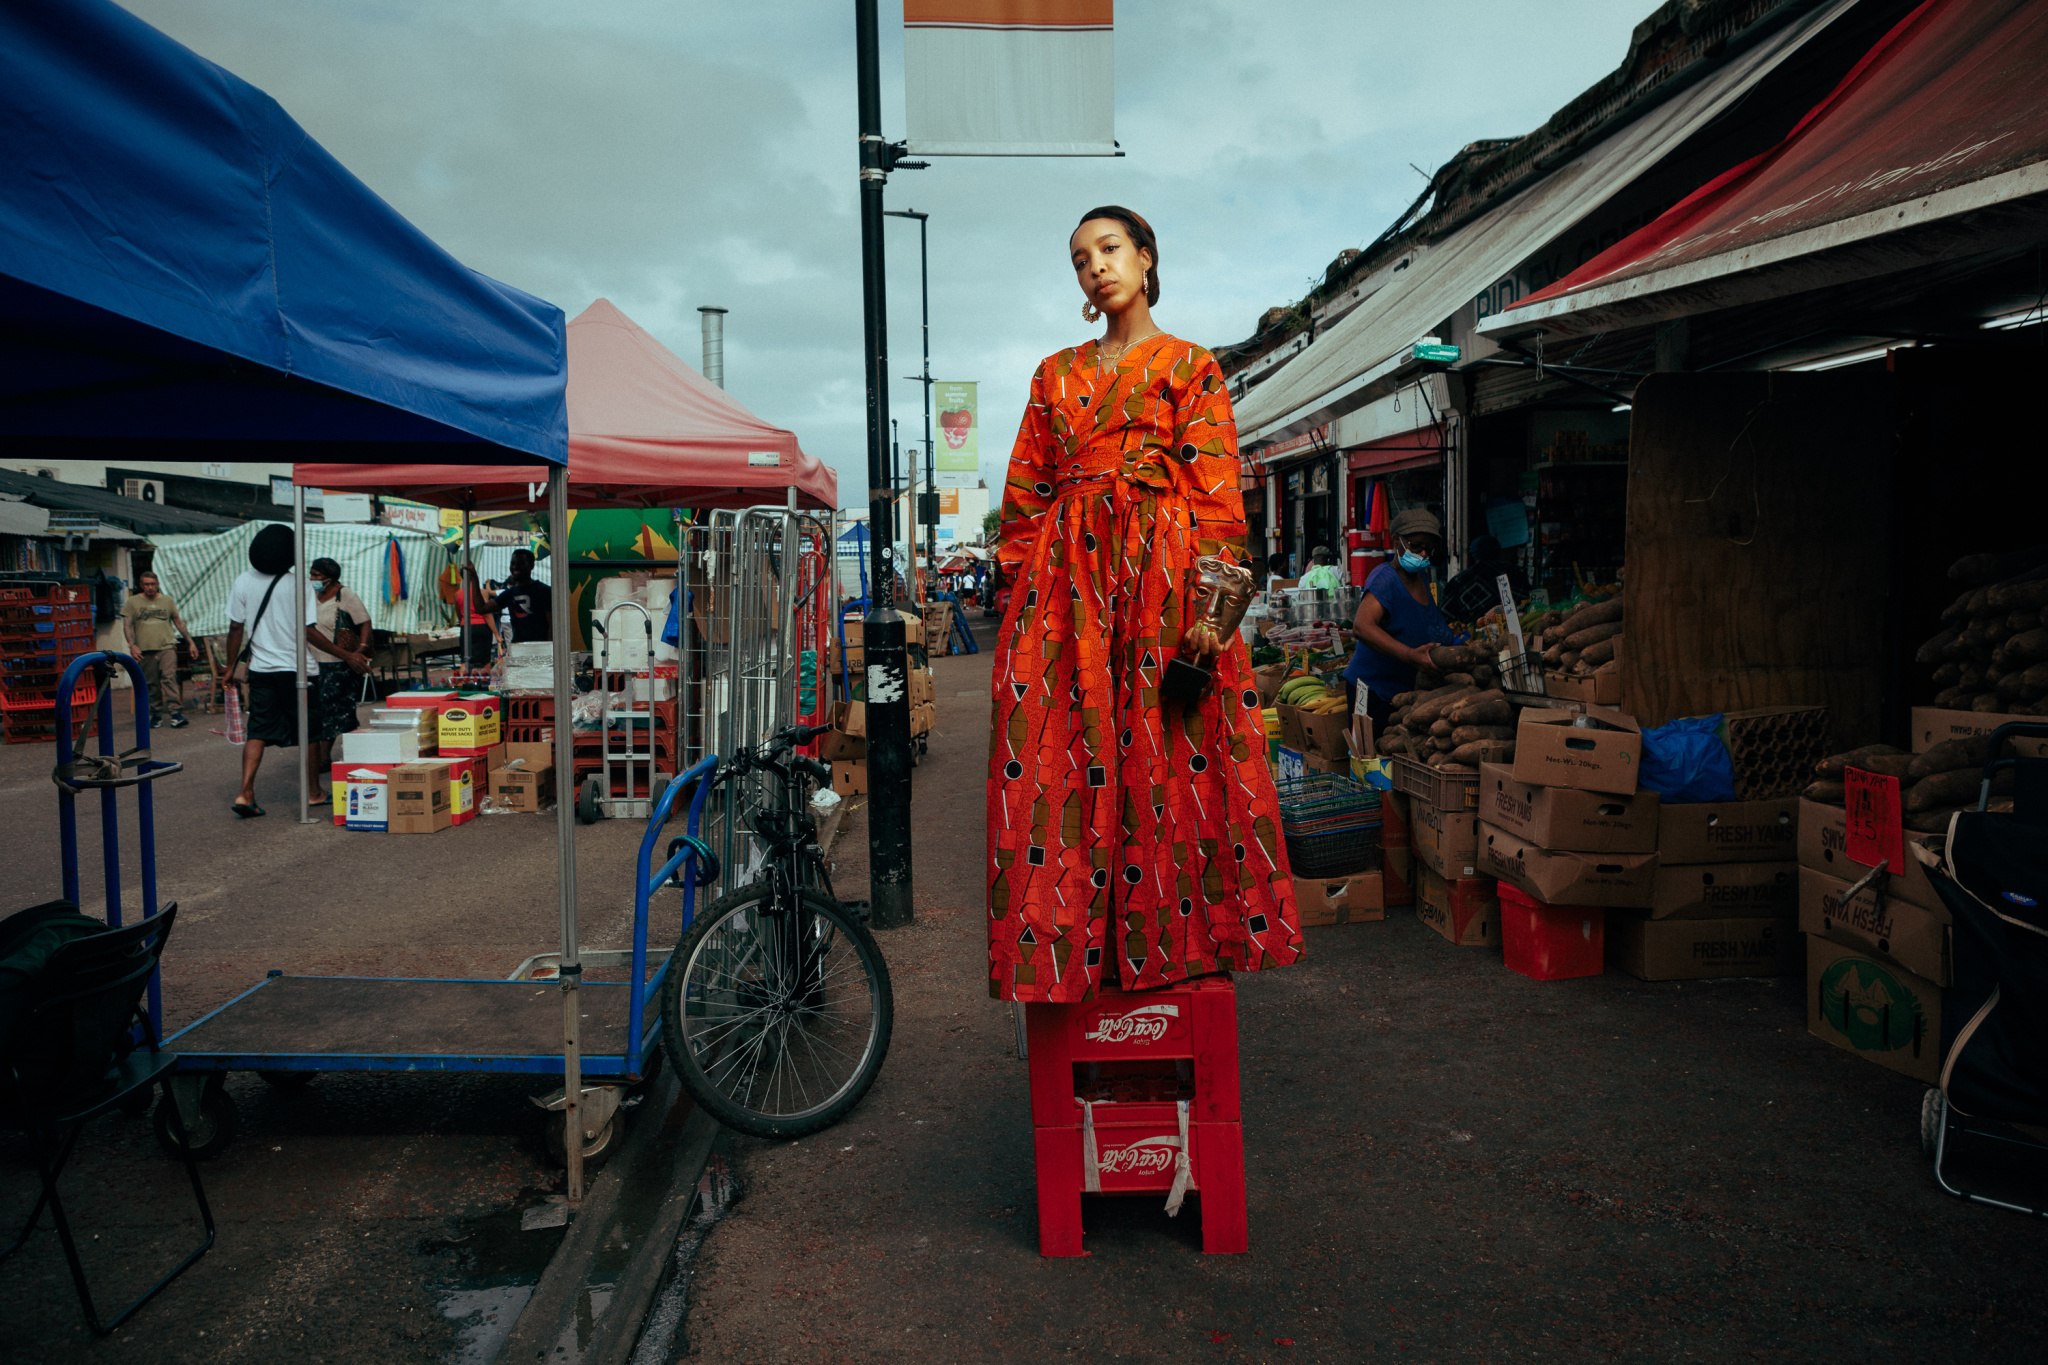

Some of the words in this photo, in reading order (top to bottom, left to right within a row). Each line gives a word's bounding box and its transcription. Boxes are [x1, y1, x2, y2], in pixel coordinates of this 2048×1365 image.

[1950, 725, 1972, 735] GHANA
[1578, 760, 1602, 770] 20kgs.
[1495, 791, 1517, 816] FRESH
[1515, 801, 1532, 823] YAMS
[1707, 826, 1752, 843] FRESH
[1756, 825, 1793, 843] YAMS
[1488, 846, 1507, 869] FRESH
[1505, 856, 1526, 879] YAMS
[1703, 885, 1750, 903] FRESH
[1753, 885, 1789, 902] YAMS
[1693, 941, 1737, 959] FRESH
[1741, 940, 1778, 958] YAMS
[1096, 1017, 1168, 1042] Coca-Cola
[1101, 1147, 1173, 1173] Coca-Cola
